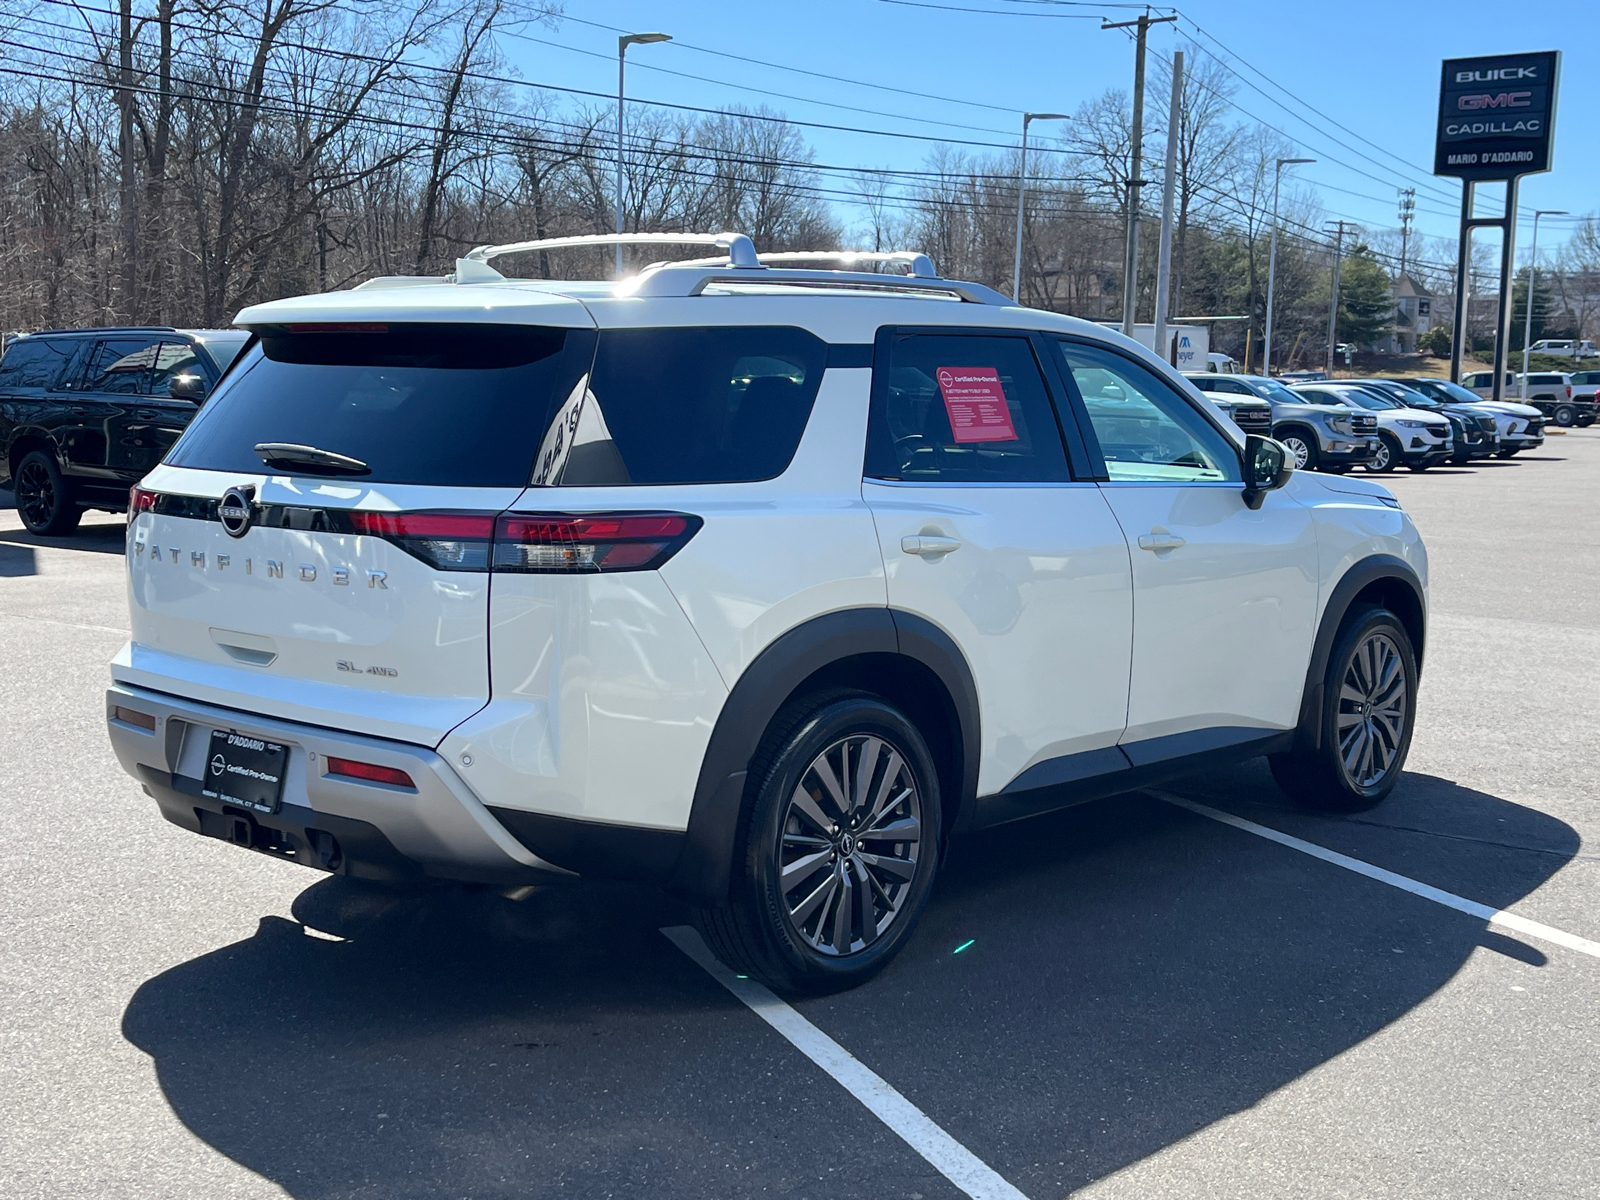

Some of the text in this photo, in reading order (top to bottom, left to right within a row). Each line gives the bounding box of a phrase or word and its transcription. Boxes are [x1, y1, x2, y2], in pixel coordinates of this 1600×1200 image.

[1456, 66, 1537, 82] BUICK
[1458, 91, 1531, 110] GMC
[1446, 120, 1540, 135] CADILLAC
[1447, 151, 1533, 164] MARIO D'ADDARIO
[218, 507, 250, 518] NSSAN
[135, 541, 388, 589] PATHFINDER
[336, 660, 398, 677] SL 4WD
[227, 734, 265, 751] D'ADDARIO
[226, 764, 249, 776] Certified
